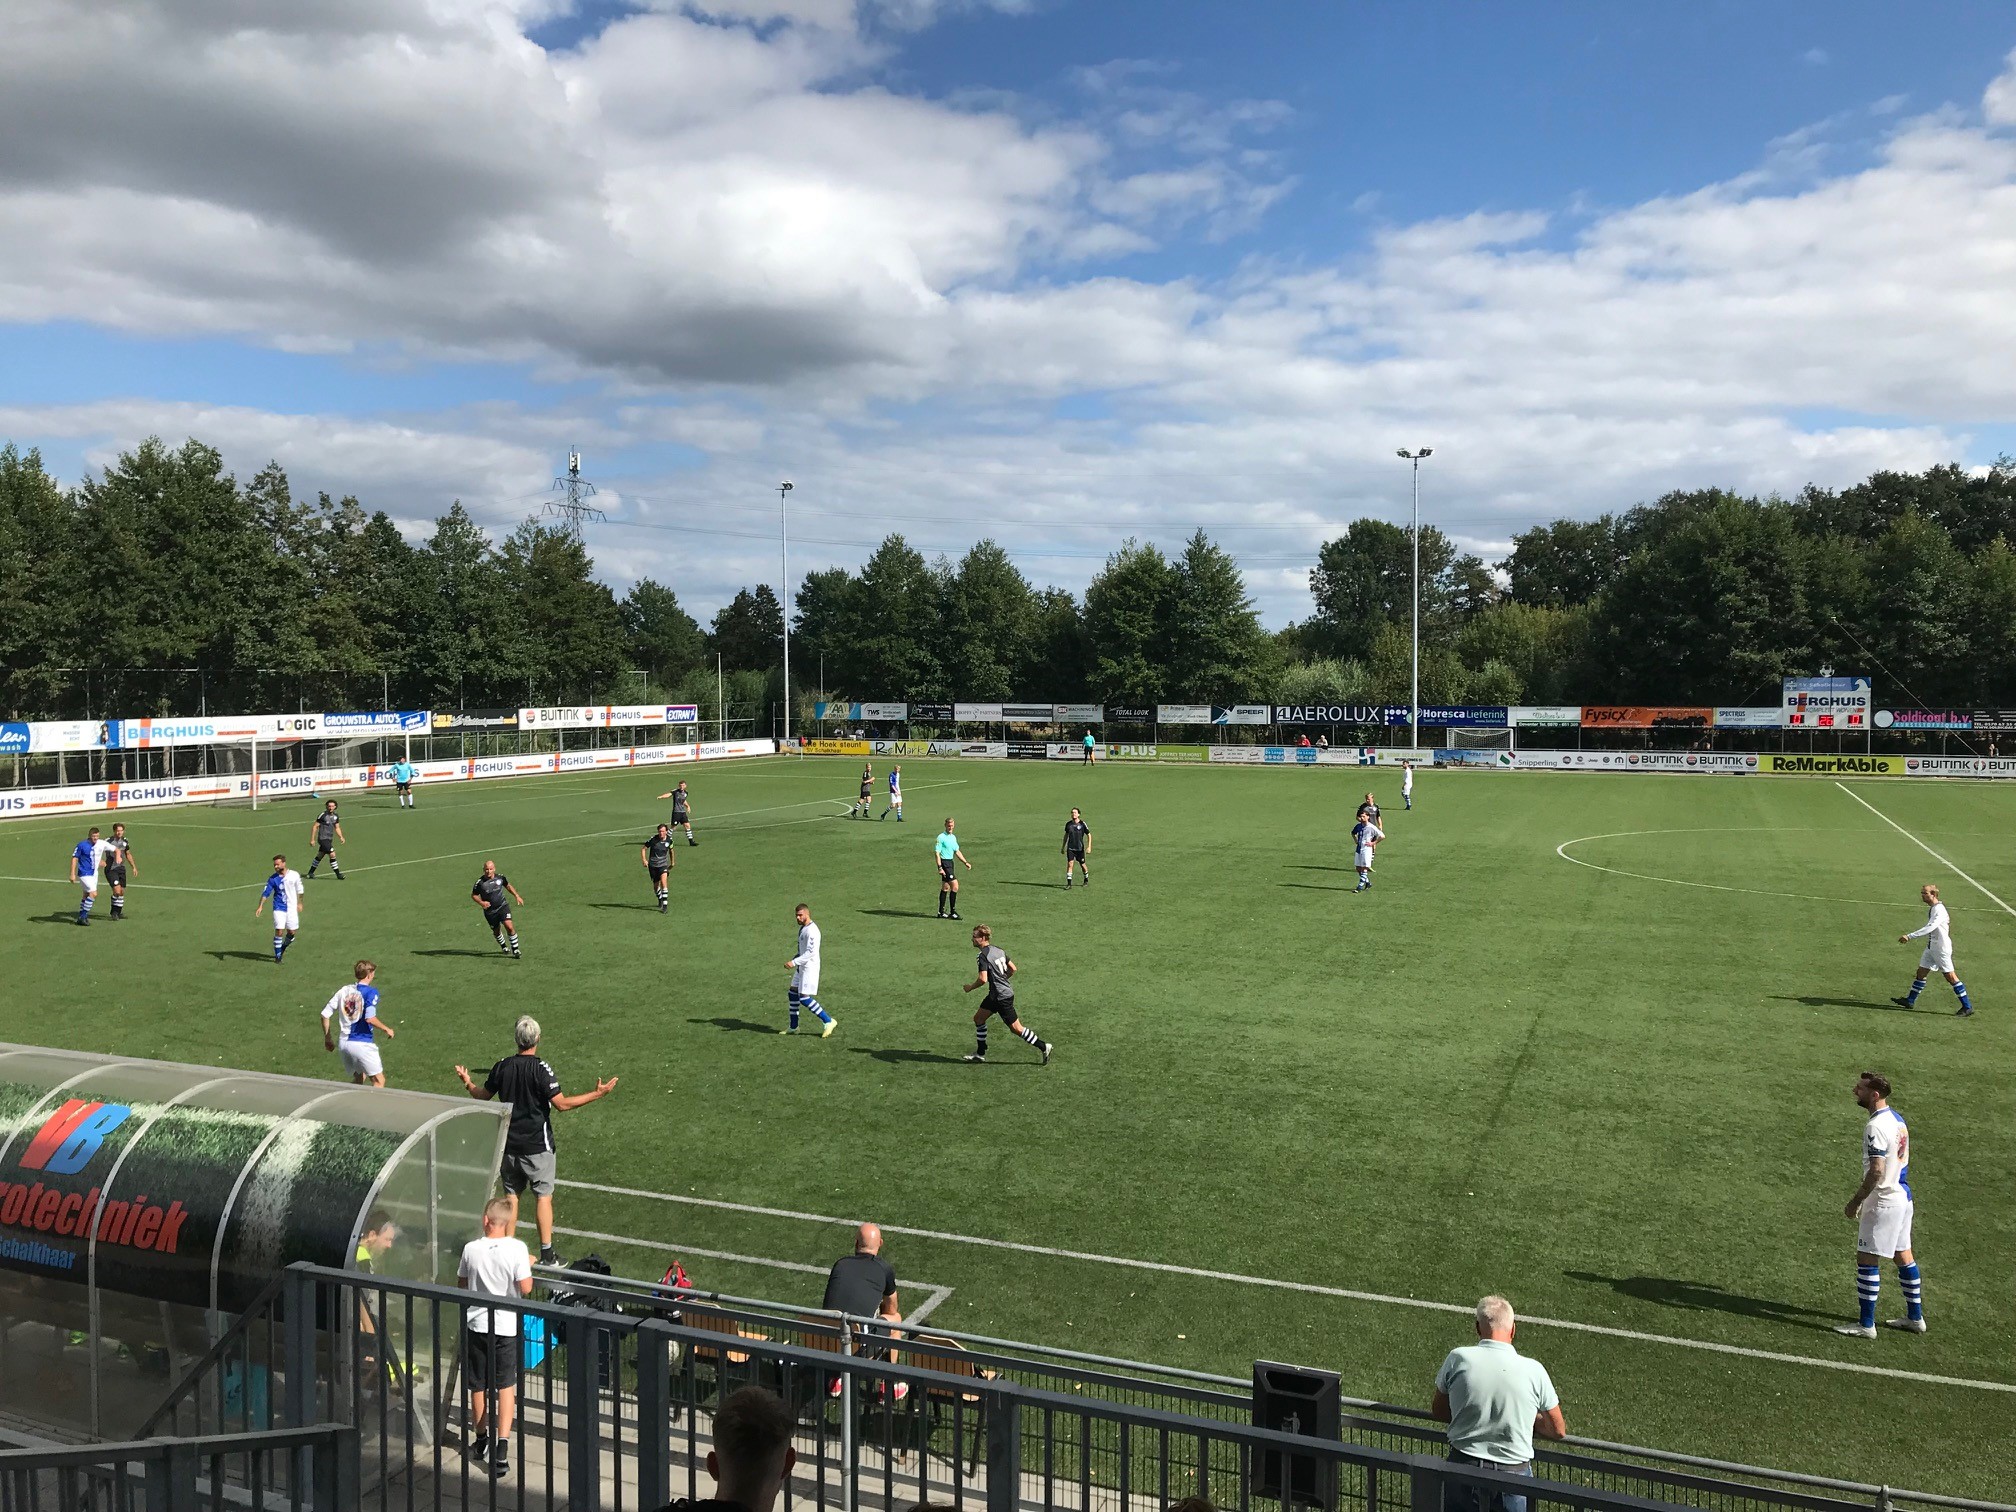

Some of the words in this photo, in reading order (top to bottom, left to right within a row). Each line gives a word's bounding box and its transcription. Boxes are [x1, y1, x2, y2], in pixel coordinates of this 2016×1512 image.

[1787, 697, 1866, 706] BERGHUIS
[540, 709, 579, 721] BUITINK
[600, 711, 641, 720] BERGHUIS
[1291, 706, 1379, 721] AEROLUX
[1423, 709, 1465, 718] Horesca
[1466, 709, 1505, 718] Lieferink
[1894, 711, 1947, 722] Soldicoat
[1950, 711, 1972, 723] b.v.
[325, 714, 373, 726] GROUWSTRA
[374, 713, 400, 725] AUTO'S
[127, 724, 214, 739] BERGHUIS
[786, 740, 796, 748] De
[819, 740, 837, 748] Hoek
[624, 750, 664, 761] BERGHUIS
[690, 746, 726, 756] BERGHUIS
[1120, 745, 1157, 756] PLUS
[548, 755, 594, 767] BERGHUIS
[1518, 759, 1558, 767] Snipperling
[1641, 755, 1683, 764] BUITINK
[1700, 756, 1743, 765] BUITINK
[1772, 756, 1890, 773] ReMarkAble
[1922, 760, 1970, 769] BUITINK
[461, 761, 513, 774] BERGHUIS
[95, 785, 183, 803] BERGHUIS
